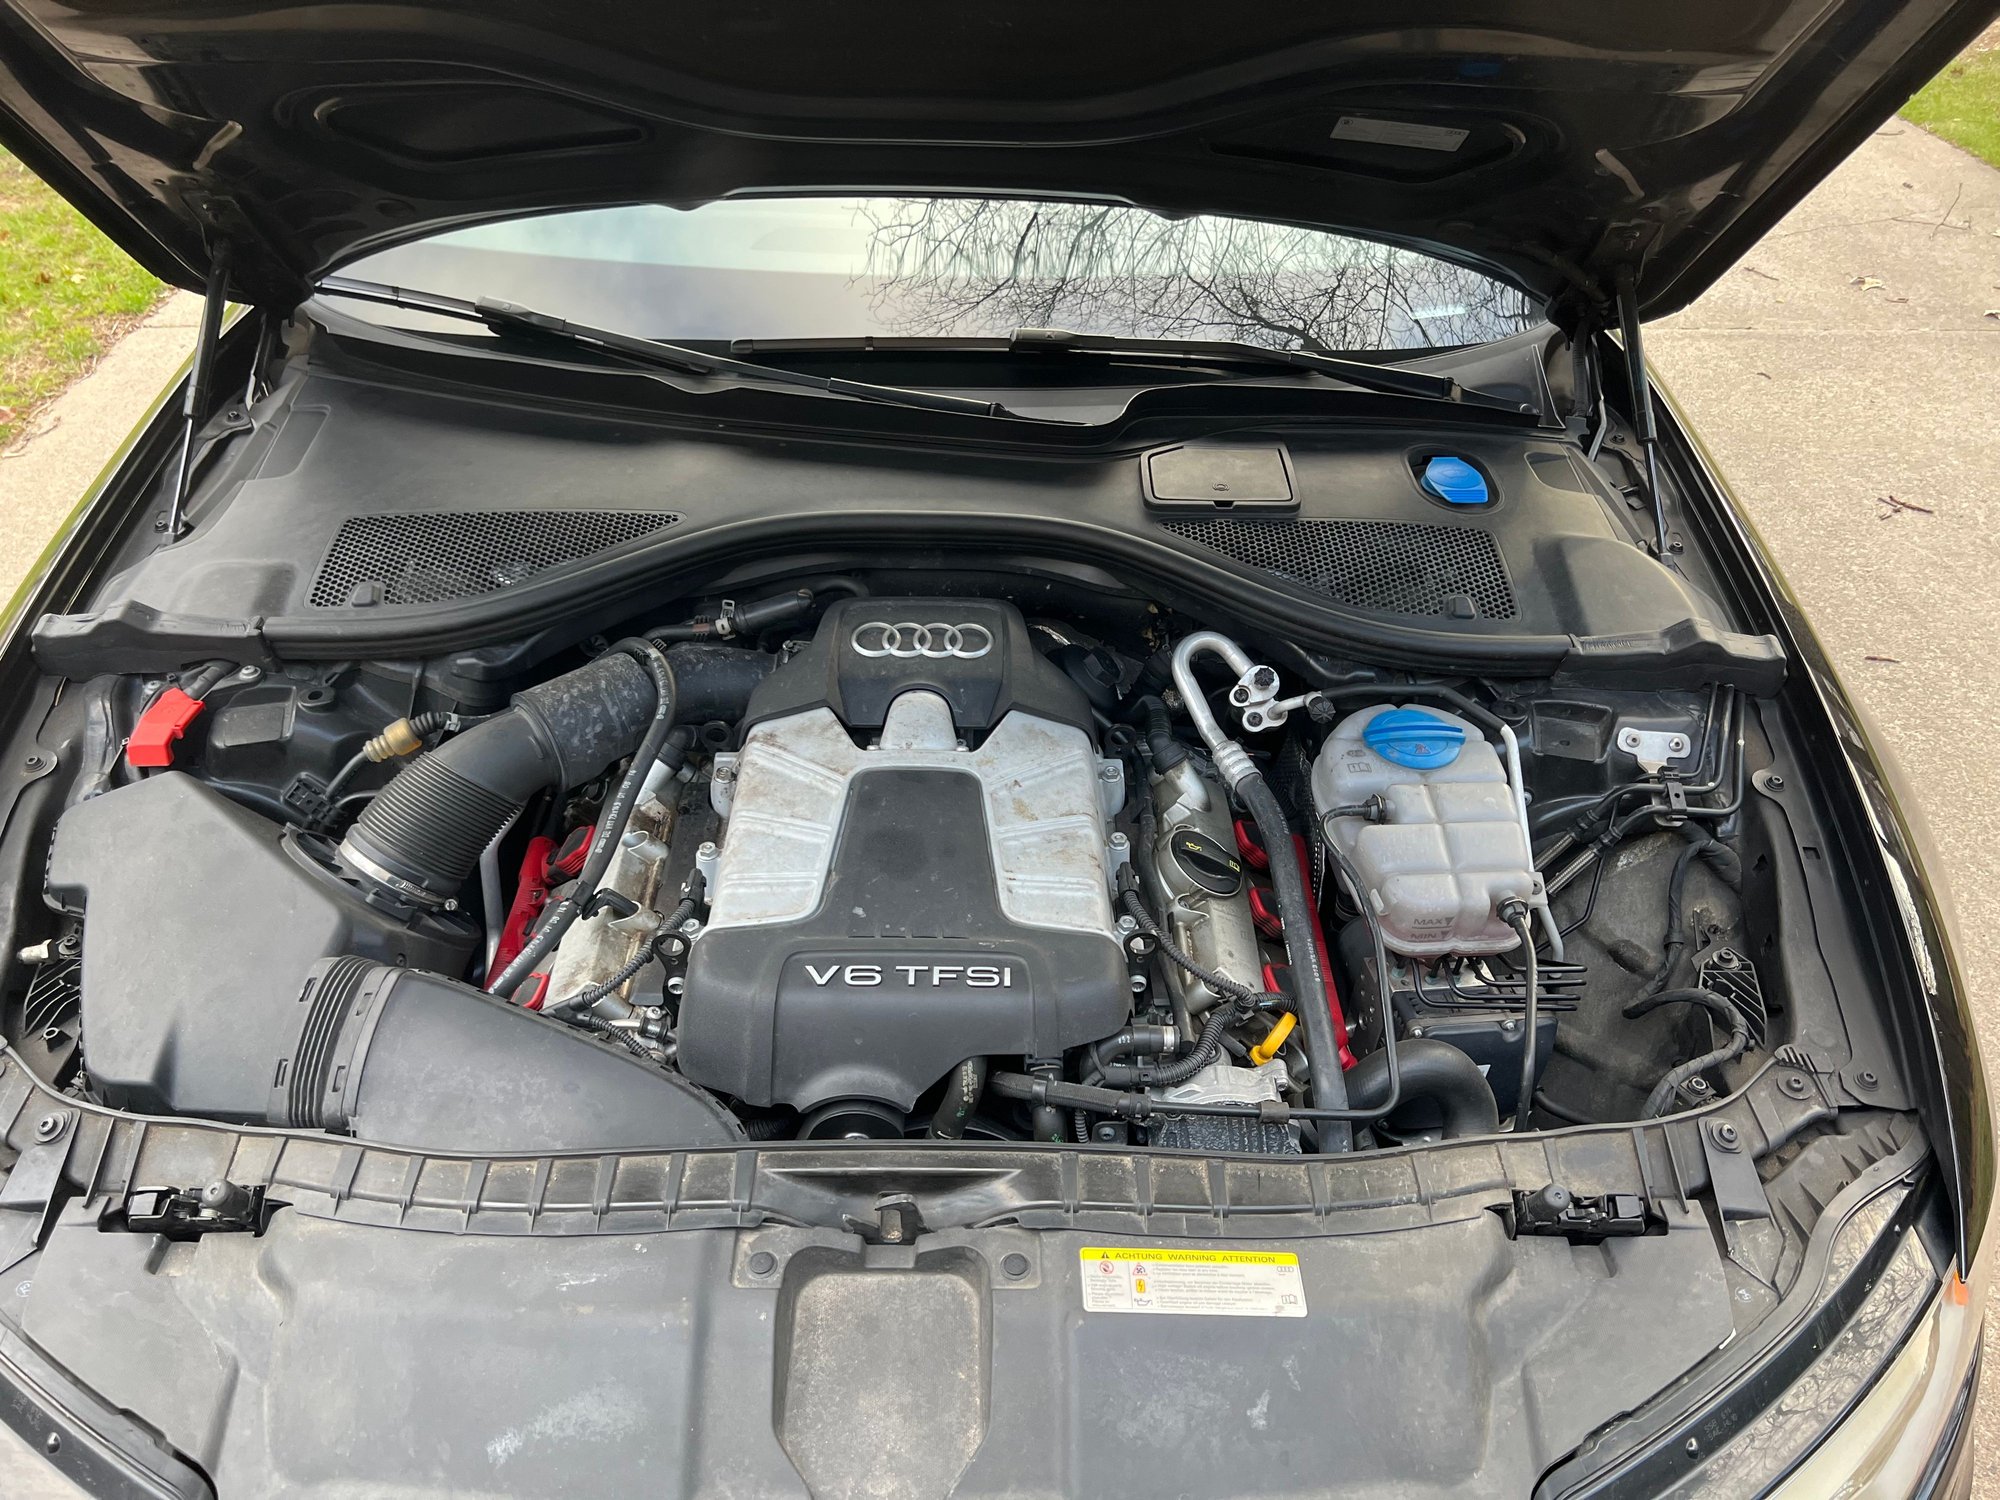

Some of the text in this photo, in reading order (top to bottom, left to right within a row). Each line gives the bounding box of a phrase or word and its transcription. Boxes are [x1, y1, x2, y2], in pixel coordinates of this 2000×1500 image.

[1413, 918, 1443, 926] MAX
[1410, 932, 1437, 940] MIN
[804, 965, 1011, 988] V6 TFSI
[1115, 1252, 1276, 1263] ACHTUNG WARNING ATTENTION
